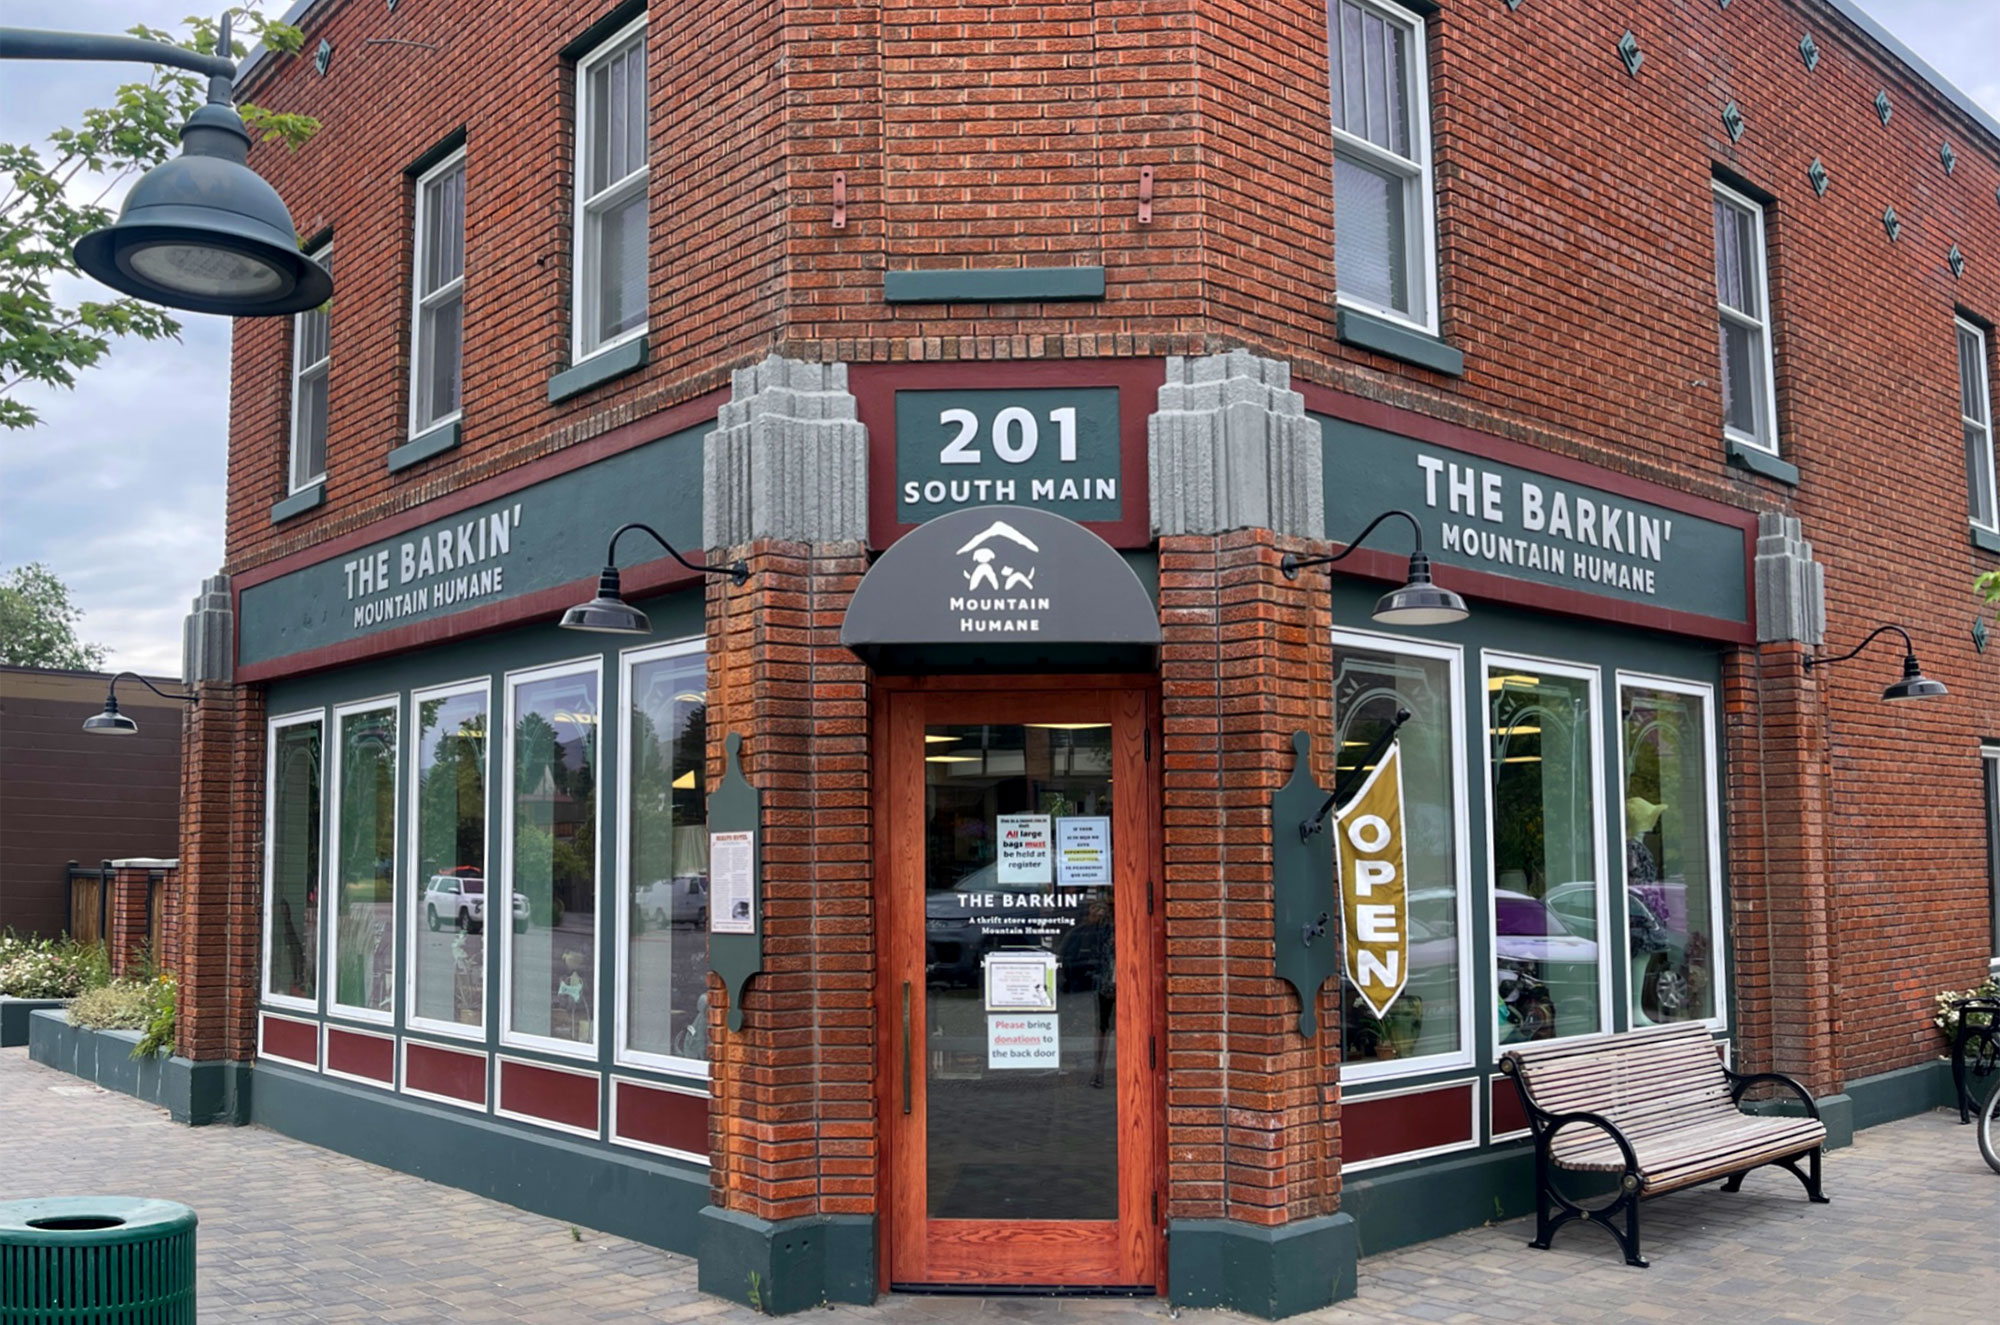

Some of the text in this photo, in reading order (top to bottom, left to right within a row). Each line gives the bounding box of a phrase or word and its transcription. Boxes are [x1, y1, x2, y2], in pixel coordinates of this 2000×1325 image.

[940, 406, 1077, 464] 201
[904, 478, 1117, 503] SOUTH MAIN
[1417, 454, 1672, 562] THE BARKIN'
[344, 503, 522, 600] THE BARKIN'
[1441, 522, 1656, 595] MOUNTAIN HUMANE
[353, 566, 503, 629] MOUNTAIN HUMANE
[950, 597, 1050, 611] MOUNTAIN
[960, 618, 1040, 631] HUMANE
[1006, 830, 1042, 839] All large
[1003, 841, 1023, 849] bags
[1008, 861, 1041, 869] register
[957, 893, 1084, 907] THE BARKIN'
[1346, 814, 1400, 988] OPEN
[977, 916, 1002, 924] thrift
[1027, 916, 1075, 926] supporting
[981, 927, 1060, 935] Mountain Humane
[995, 1020, 1052, 1030] Please bring
[994, 1035, 1053, 1045] donations to
[992, 1049, 1056, 1058] the back door
